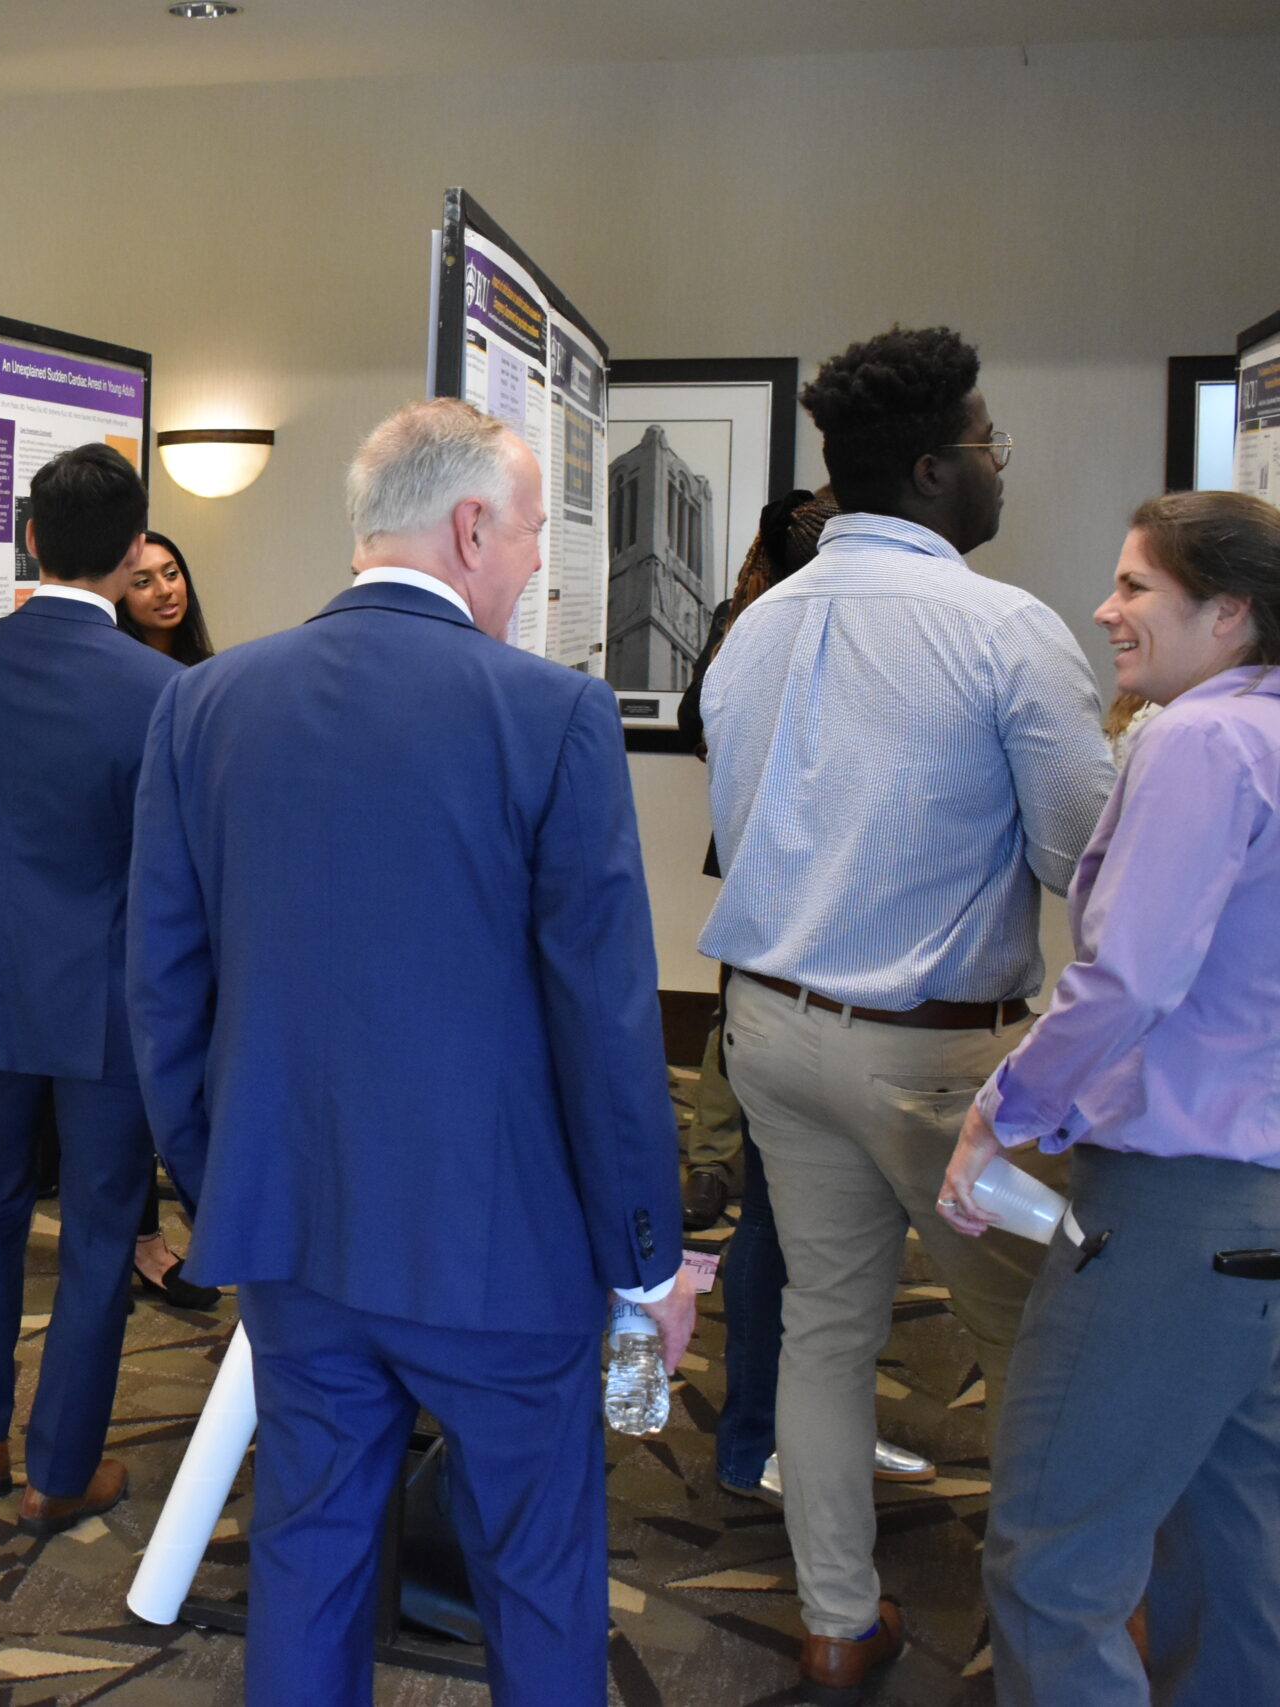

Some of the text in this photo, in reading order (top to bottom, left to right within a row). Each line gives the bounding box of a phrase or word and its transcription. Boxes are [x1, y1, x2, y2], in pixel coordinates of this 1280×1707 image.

[2, 358, 136, 398] An Unexplained Sudden Cardiac Arrest in Young Adults
